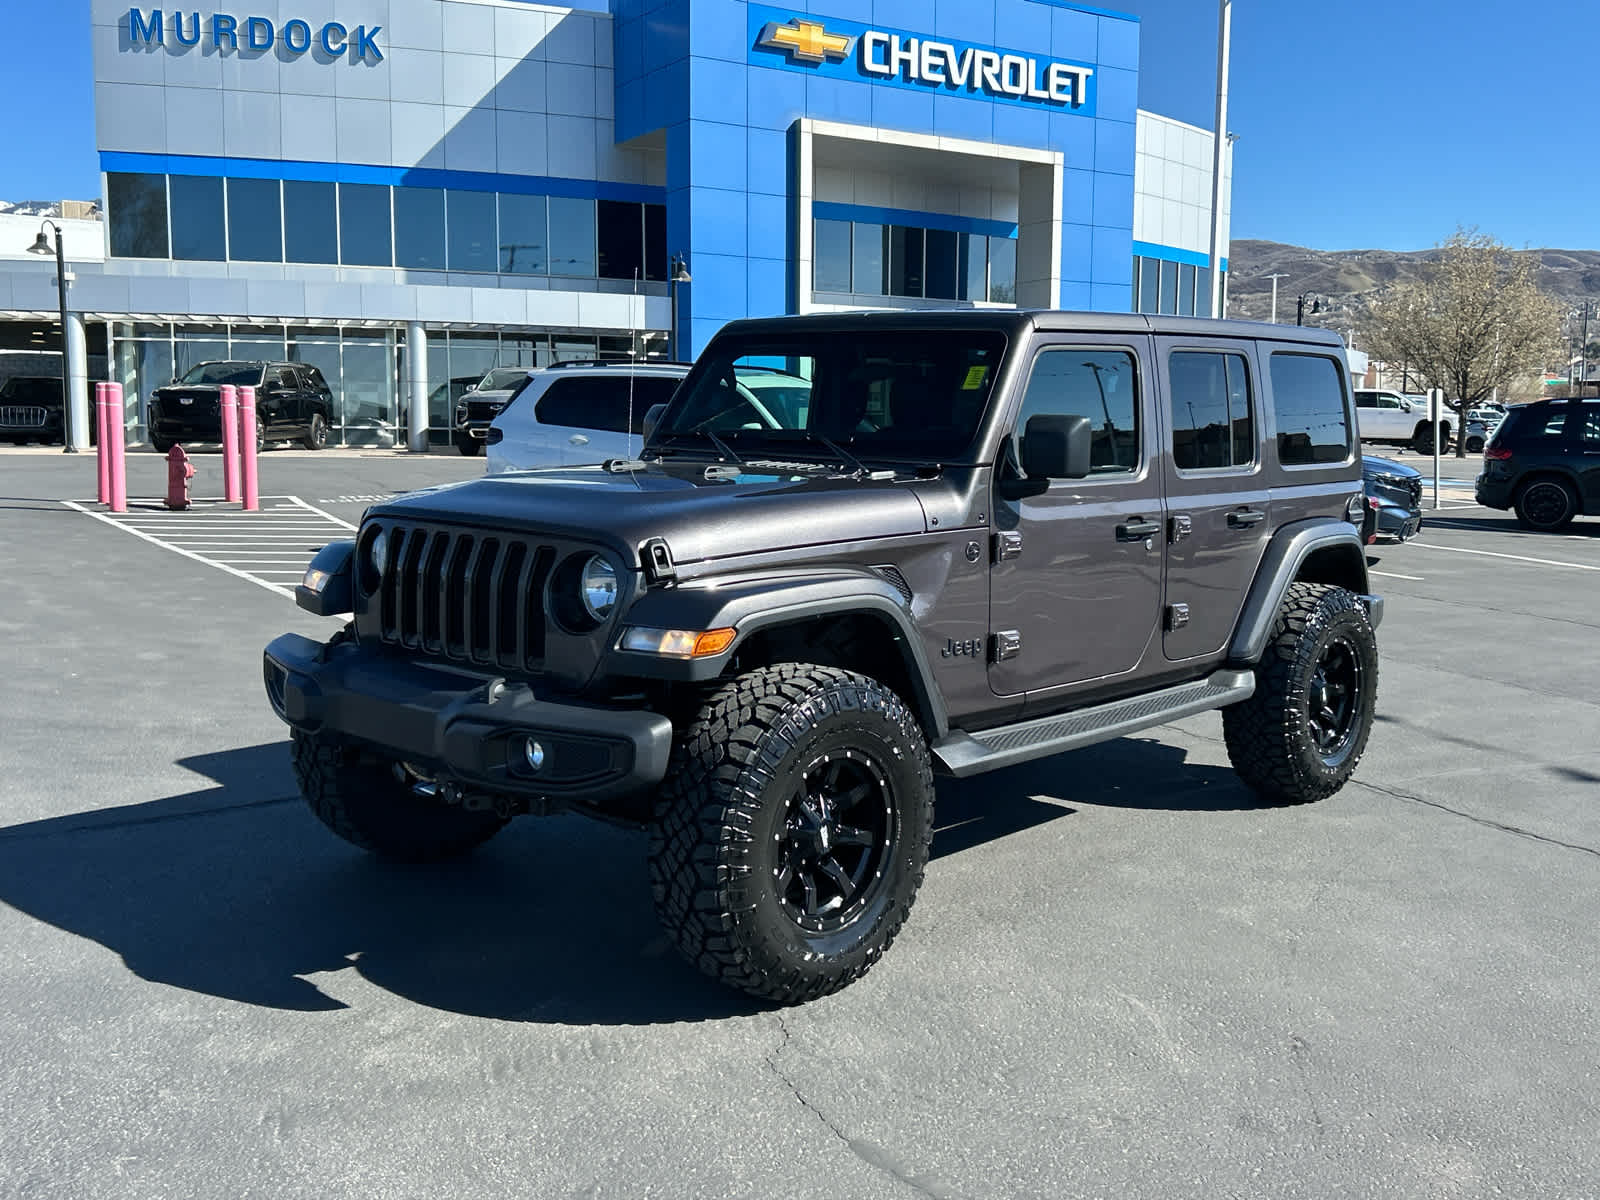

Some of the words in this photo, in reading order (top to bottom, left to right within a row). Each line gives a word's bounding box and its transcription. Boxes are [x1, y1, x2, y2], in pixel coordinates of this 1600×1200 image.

[129, 7, 384, 60] MURDOCK
[863, 30, 1094, 105] CHEVROLET
[941, 637, 983, 658] Jeep
